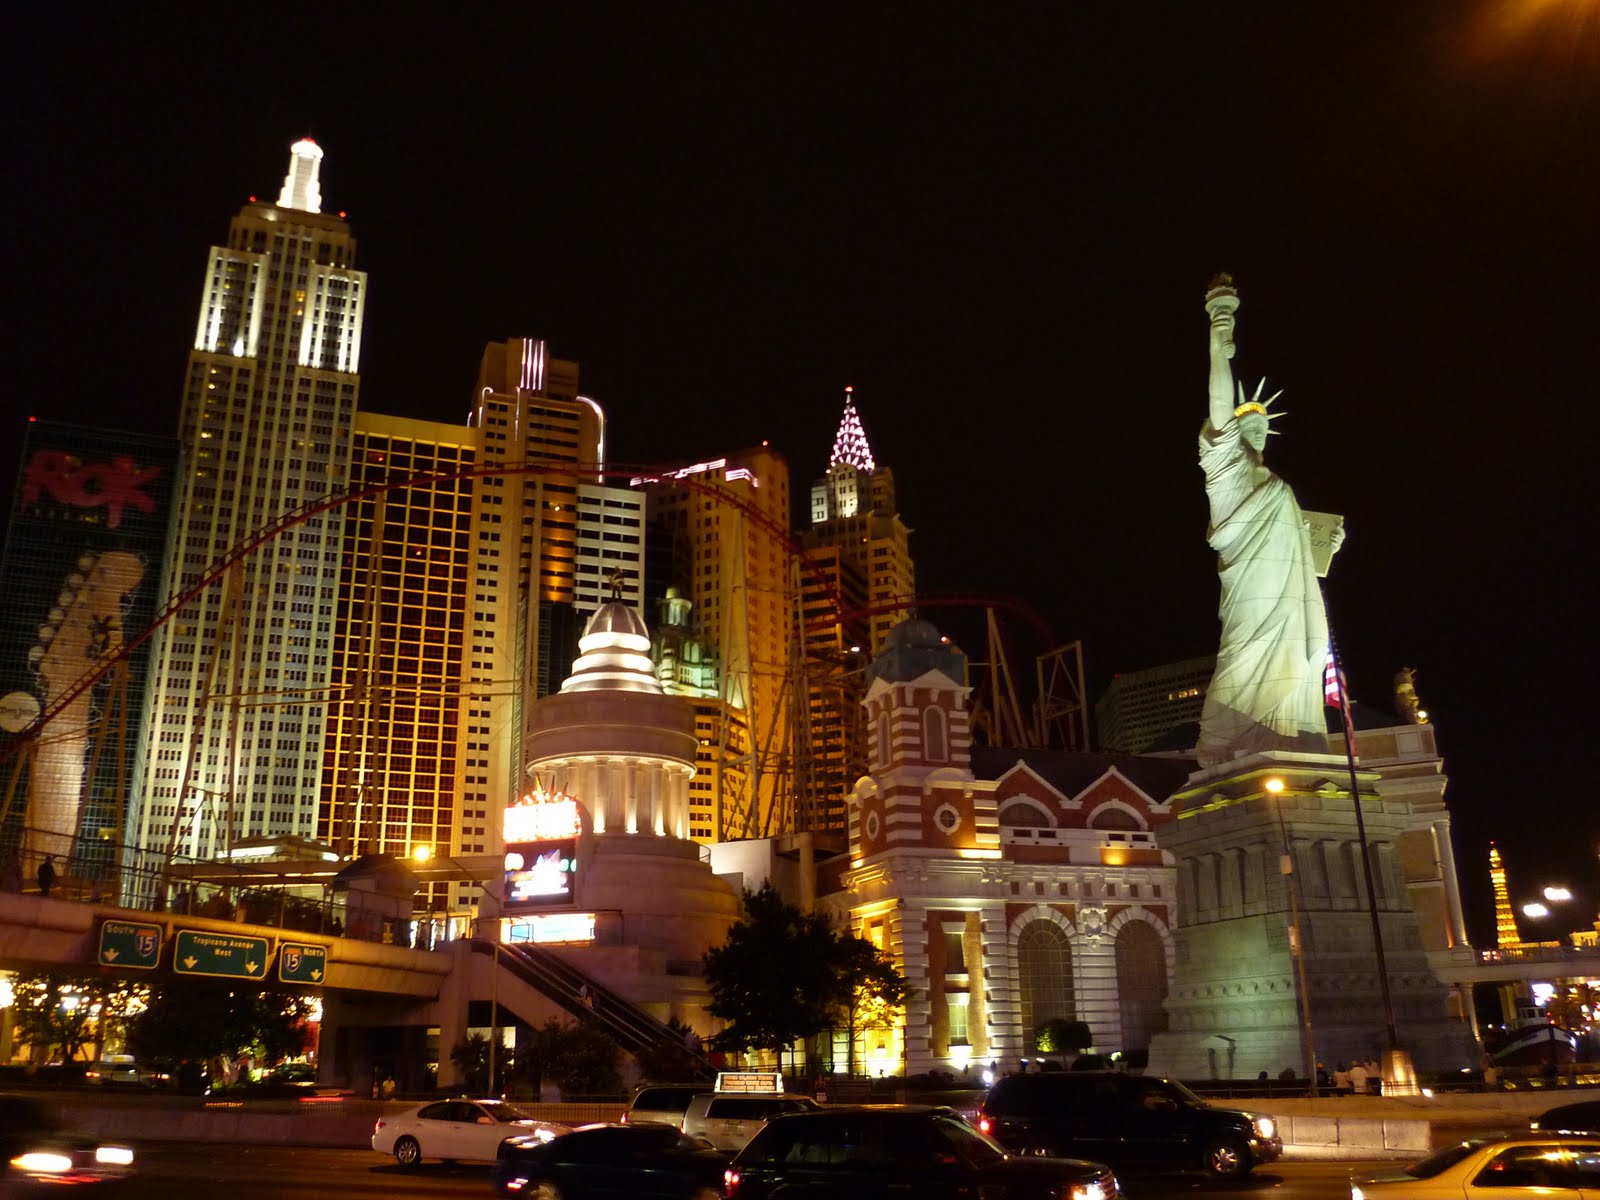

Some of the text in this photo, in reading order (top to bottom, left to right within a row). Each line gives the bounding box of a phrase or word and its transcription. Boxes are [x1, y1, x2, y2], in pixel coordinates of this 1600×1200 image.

[139, 936, 154, 951] 15
[192, 936, 255, 949] Tropicana Avenue
[214, 948, 232, 957] West
[303, 947, 325, 957] NORTH
[285, 953, 299, 967] 15
